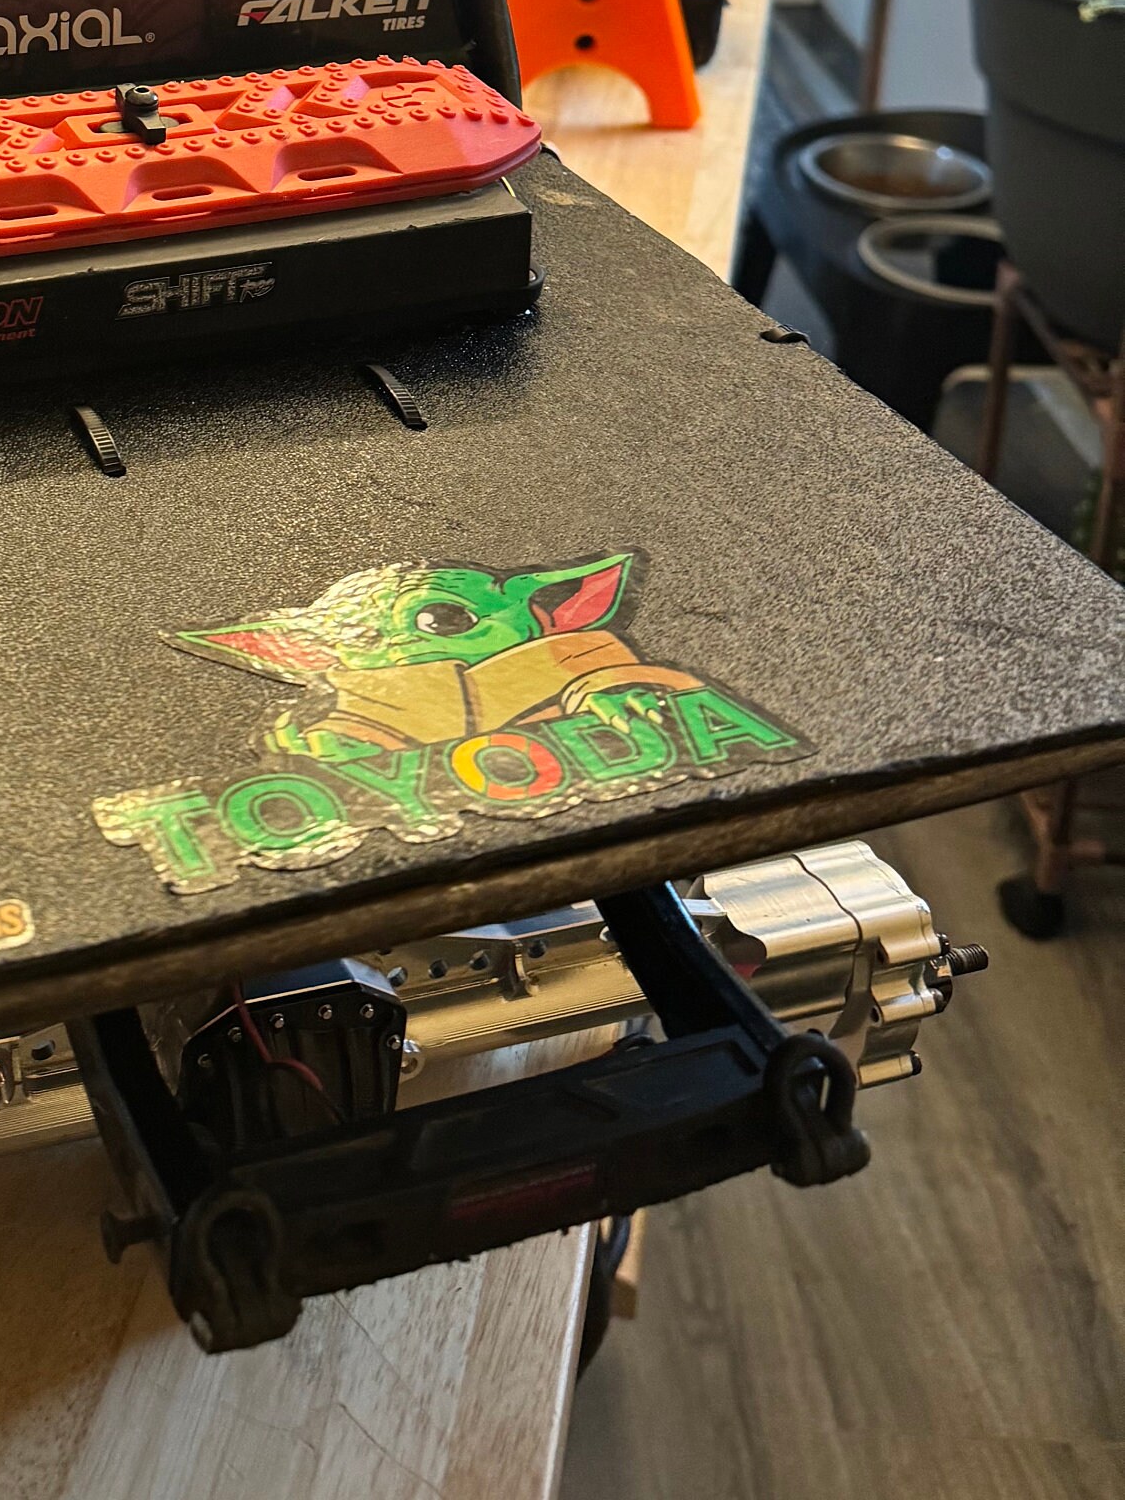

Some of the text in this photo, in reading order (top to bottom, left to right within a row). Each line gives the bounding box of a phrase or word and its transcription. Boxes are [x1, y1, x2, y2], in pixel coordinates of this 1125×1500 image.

[382, 15, 426, 32] TIRES
[115, 262, 273, 320] SHIFT
[103, 685, 800, 886] TOYODA
